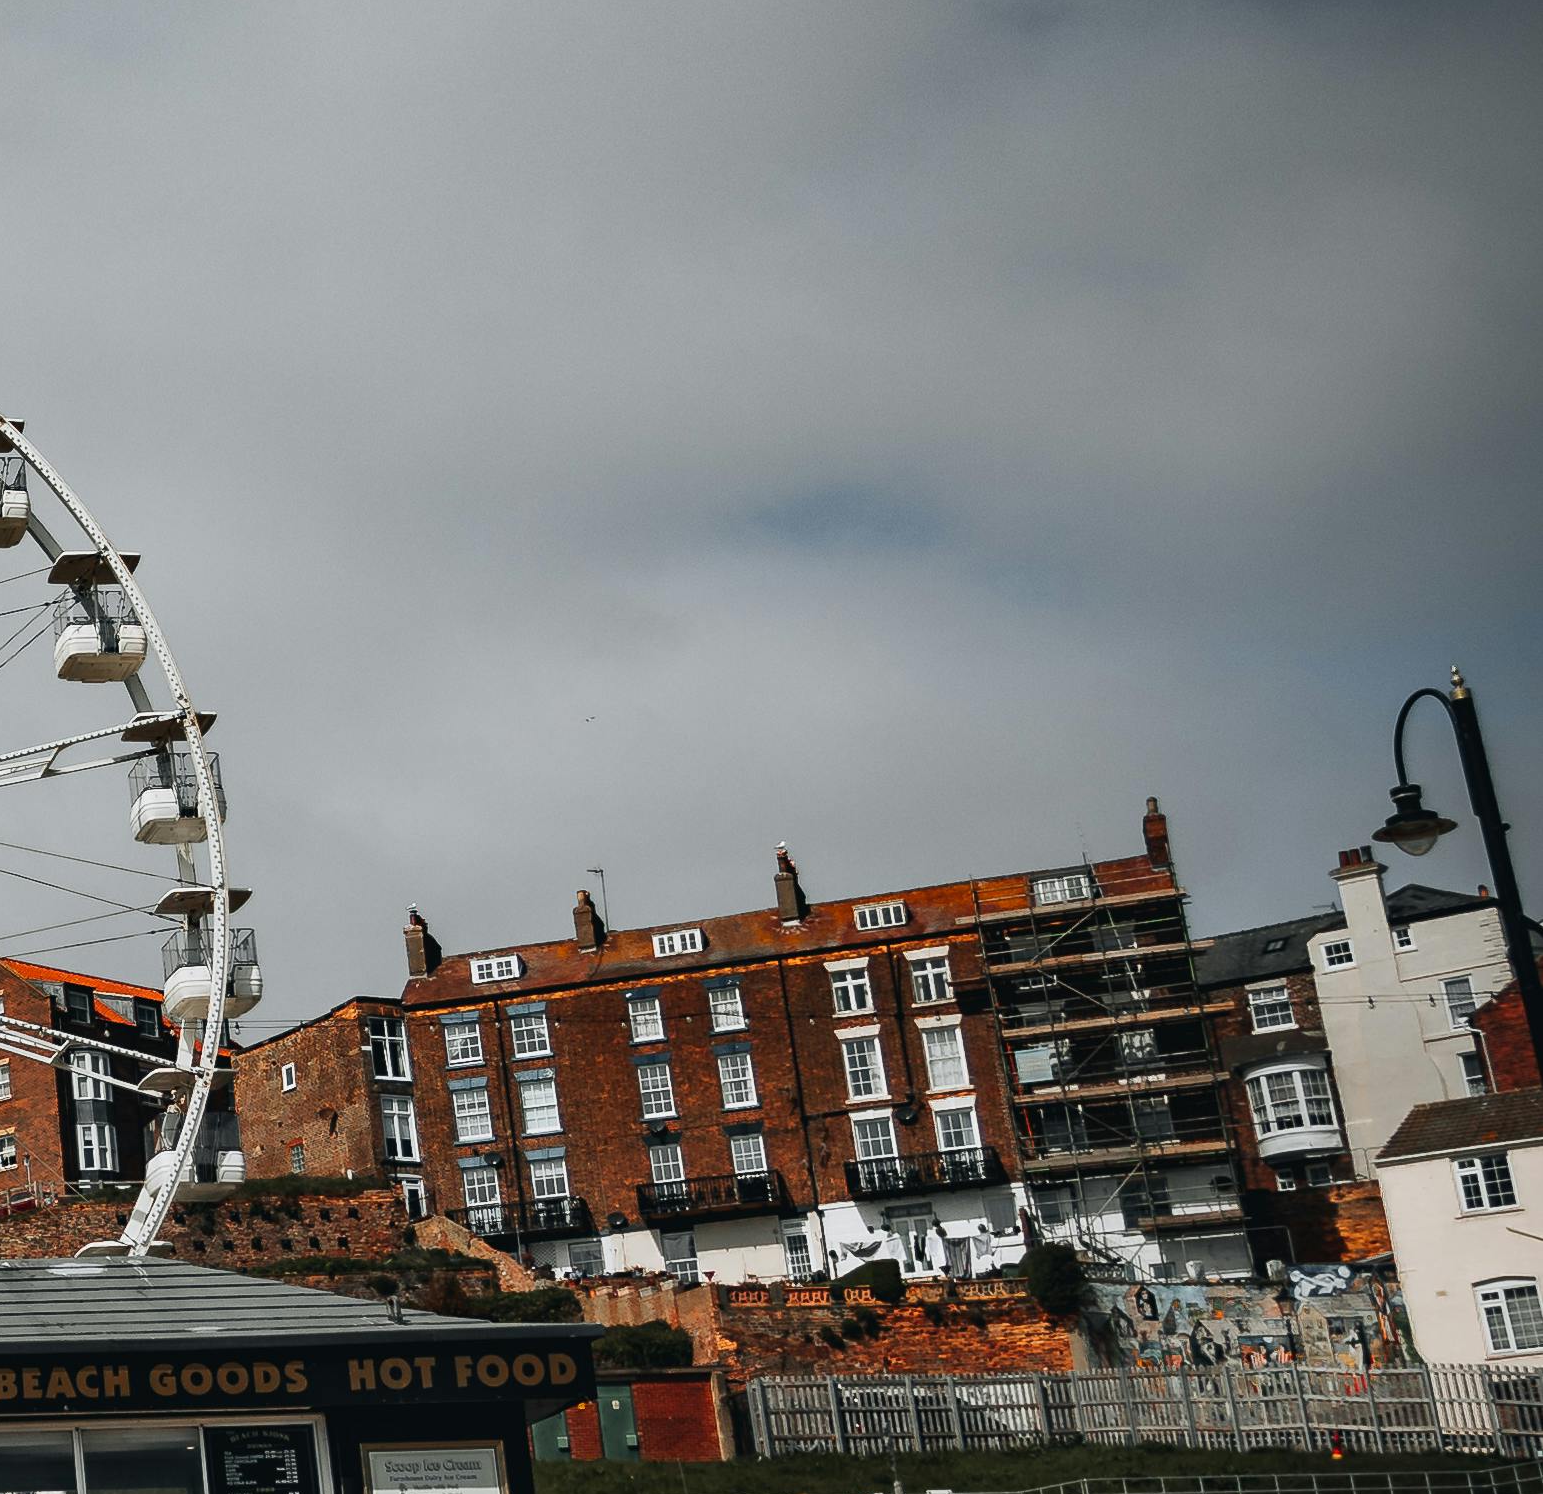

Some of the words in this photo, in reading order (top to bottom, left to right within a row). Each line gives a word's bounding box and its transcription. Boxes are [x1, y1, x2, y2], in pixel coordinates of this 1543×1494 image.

[149, 1360, 308, 1396] GOODS
[348, 1357, 436, 1391] HOT
[455, 1353, 577, 1388] FOOD
[385, 1460, 420, 1474] Scoop
[423, 1459, 441, 1472] Ice
[443, 1459, 482, 1471] Cream
